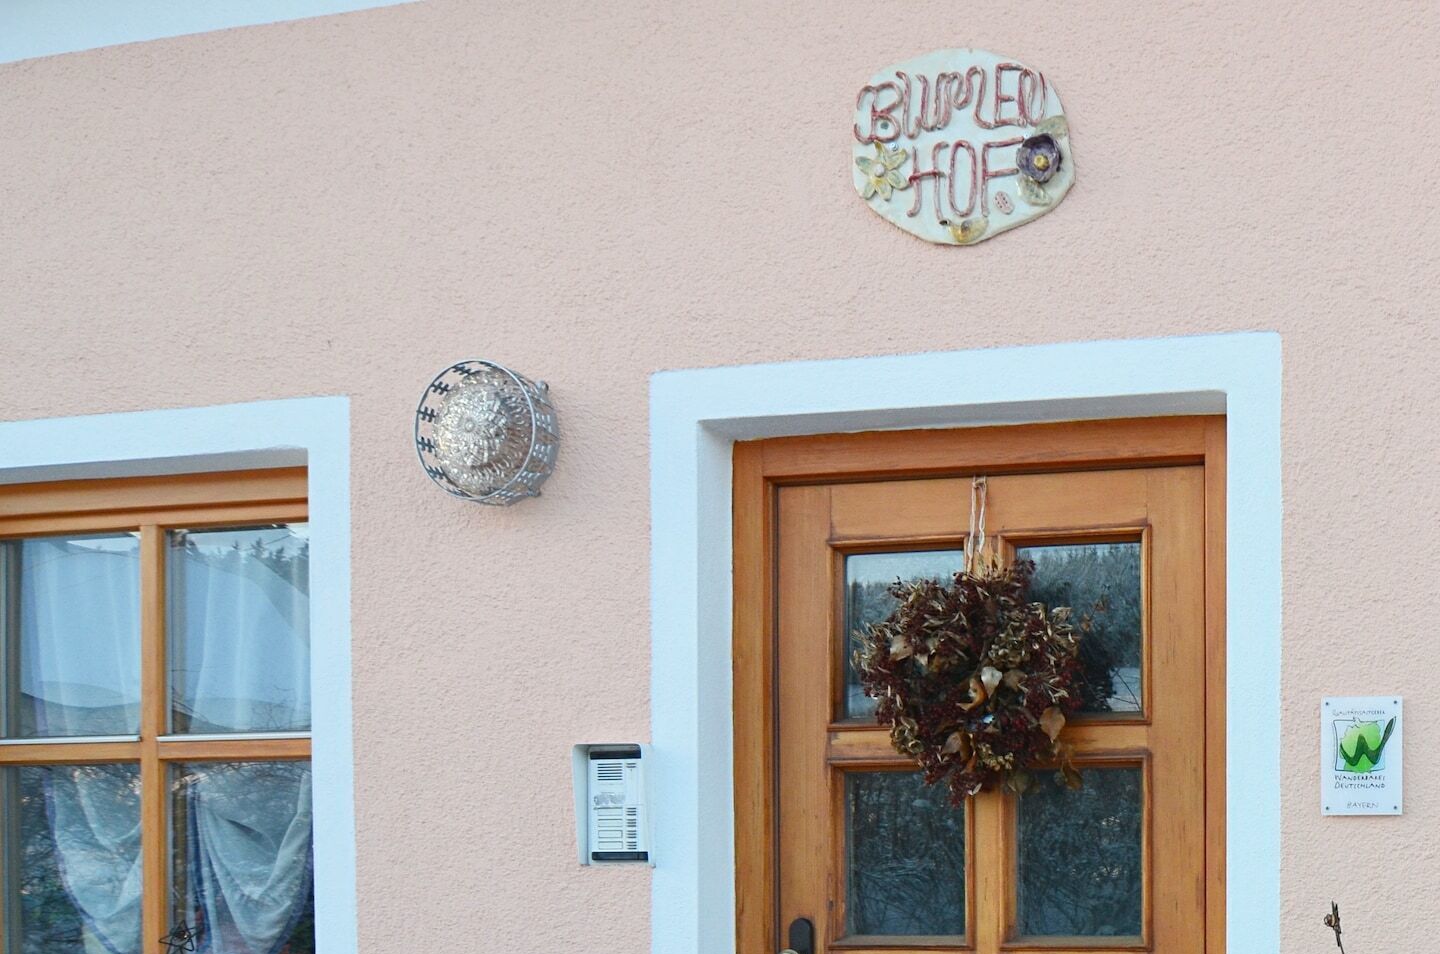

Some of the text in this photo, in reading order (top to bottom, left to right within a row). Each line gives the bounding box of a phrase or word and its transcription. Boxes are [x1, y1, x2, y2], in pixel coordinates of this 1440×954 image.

[853, 62, 1048, 144] BLUMEN
[906, 136, 1026, 225] HOF
[1334, 781, 1386, 790] DEUTSCHLAND
[1346, 801, 1379, 809] BAYERN
